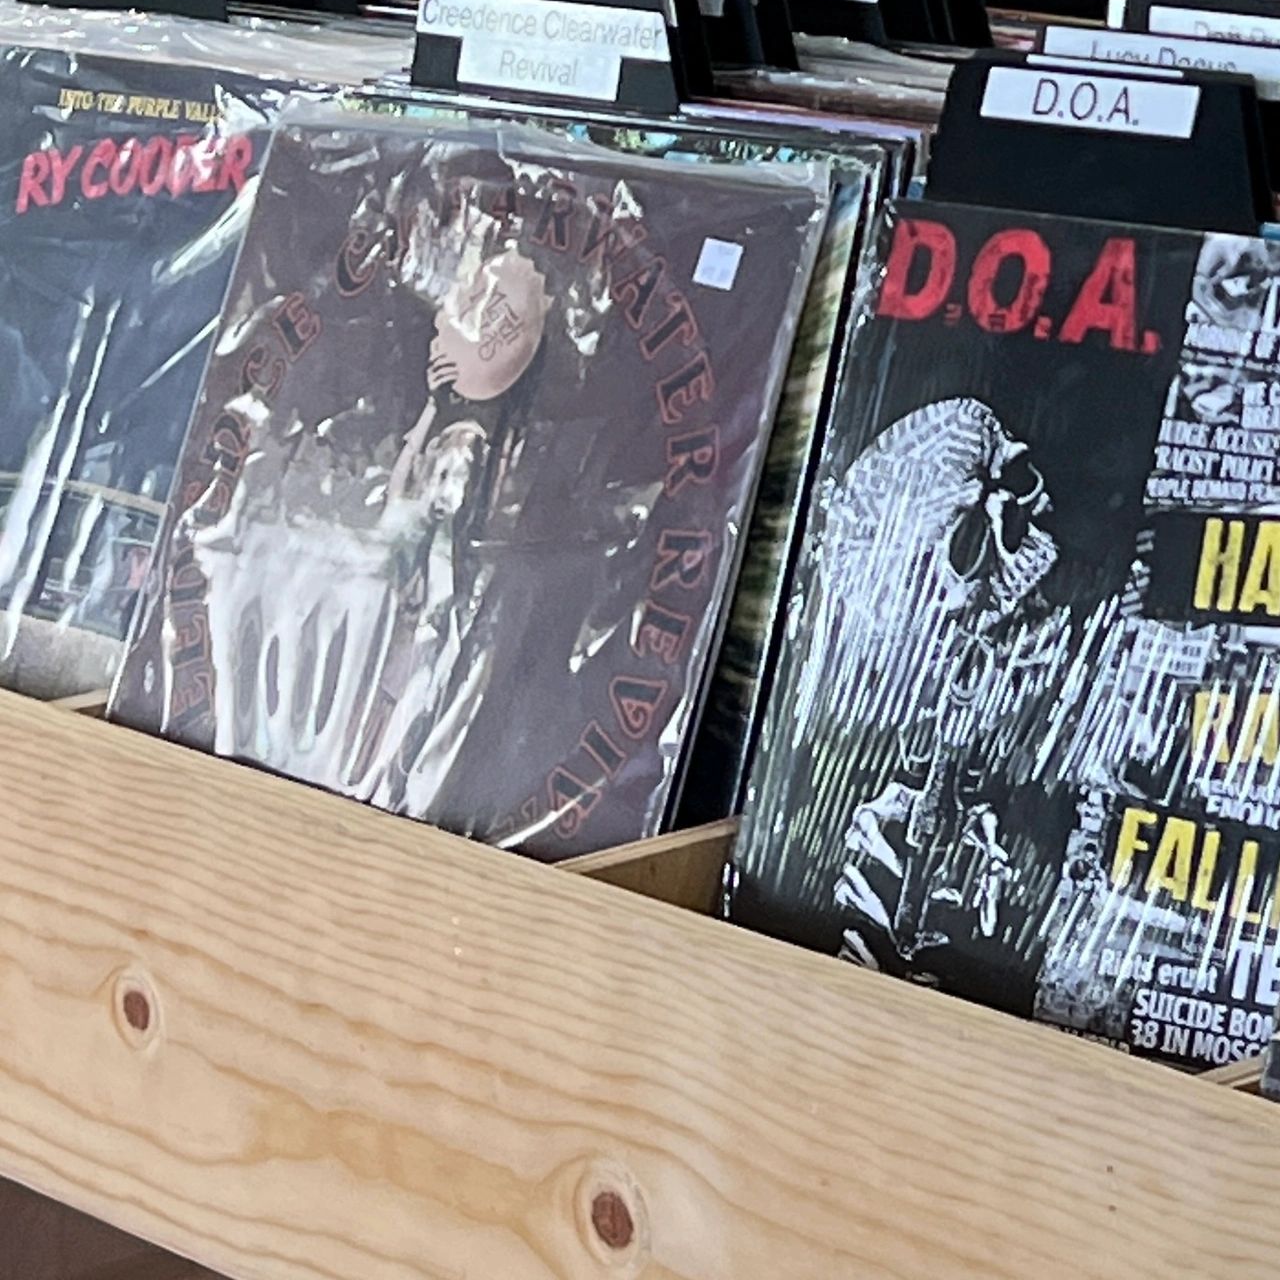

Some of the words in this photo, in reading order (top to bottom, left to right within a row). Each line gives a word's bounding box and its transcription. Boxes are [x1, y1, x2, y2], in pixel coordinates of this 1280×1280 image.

[543, 10, 663, 50] Clearwater
[499, 49, 579, 86] Revival
[126, 95, 182, 119] PURPLE
[1031, 77, 1140, 128] D.O.A.
[15, 144, 83, 215] RY
[877, 218, 1164, 357] D.O.A.
[1132, 988, 1228, 1033] SUICIDE
[1130, 1018, 1160, 1050] 38
[1161, 1023, 1191, 1056] IN
